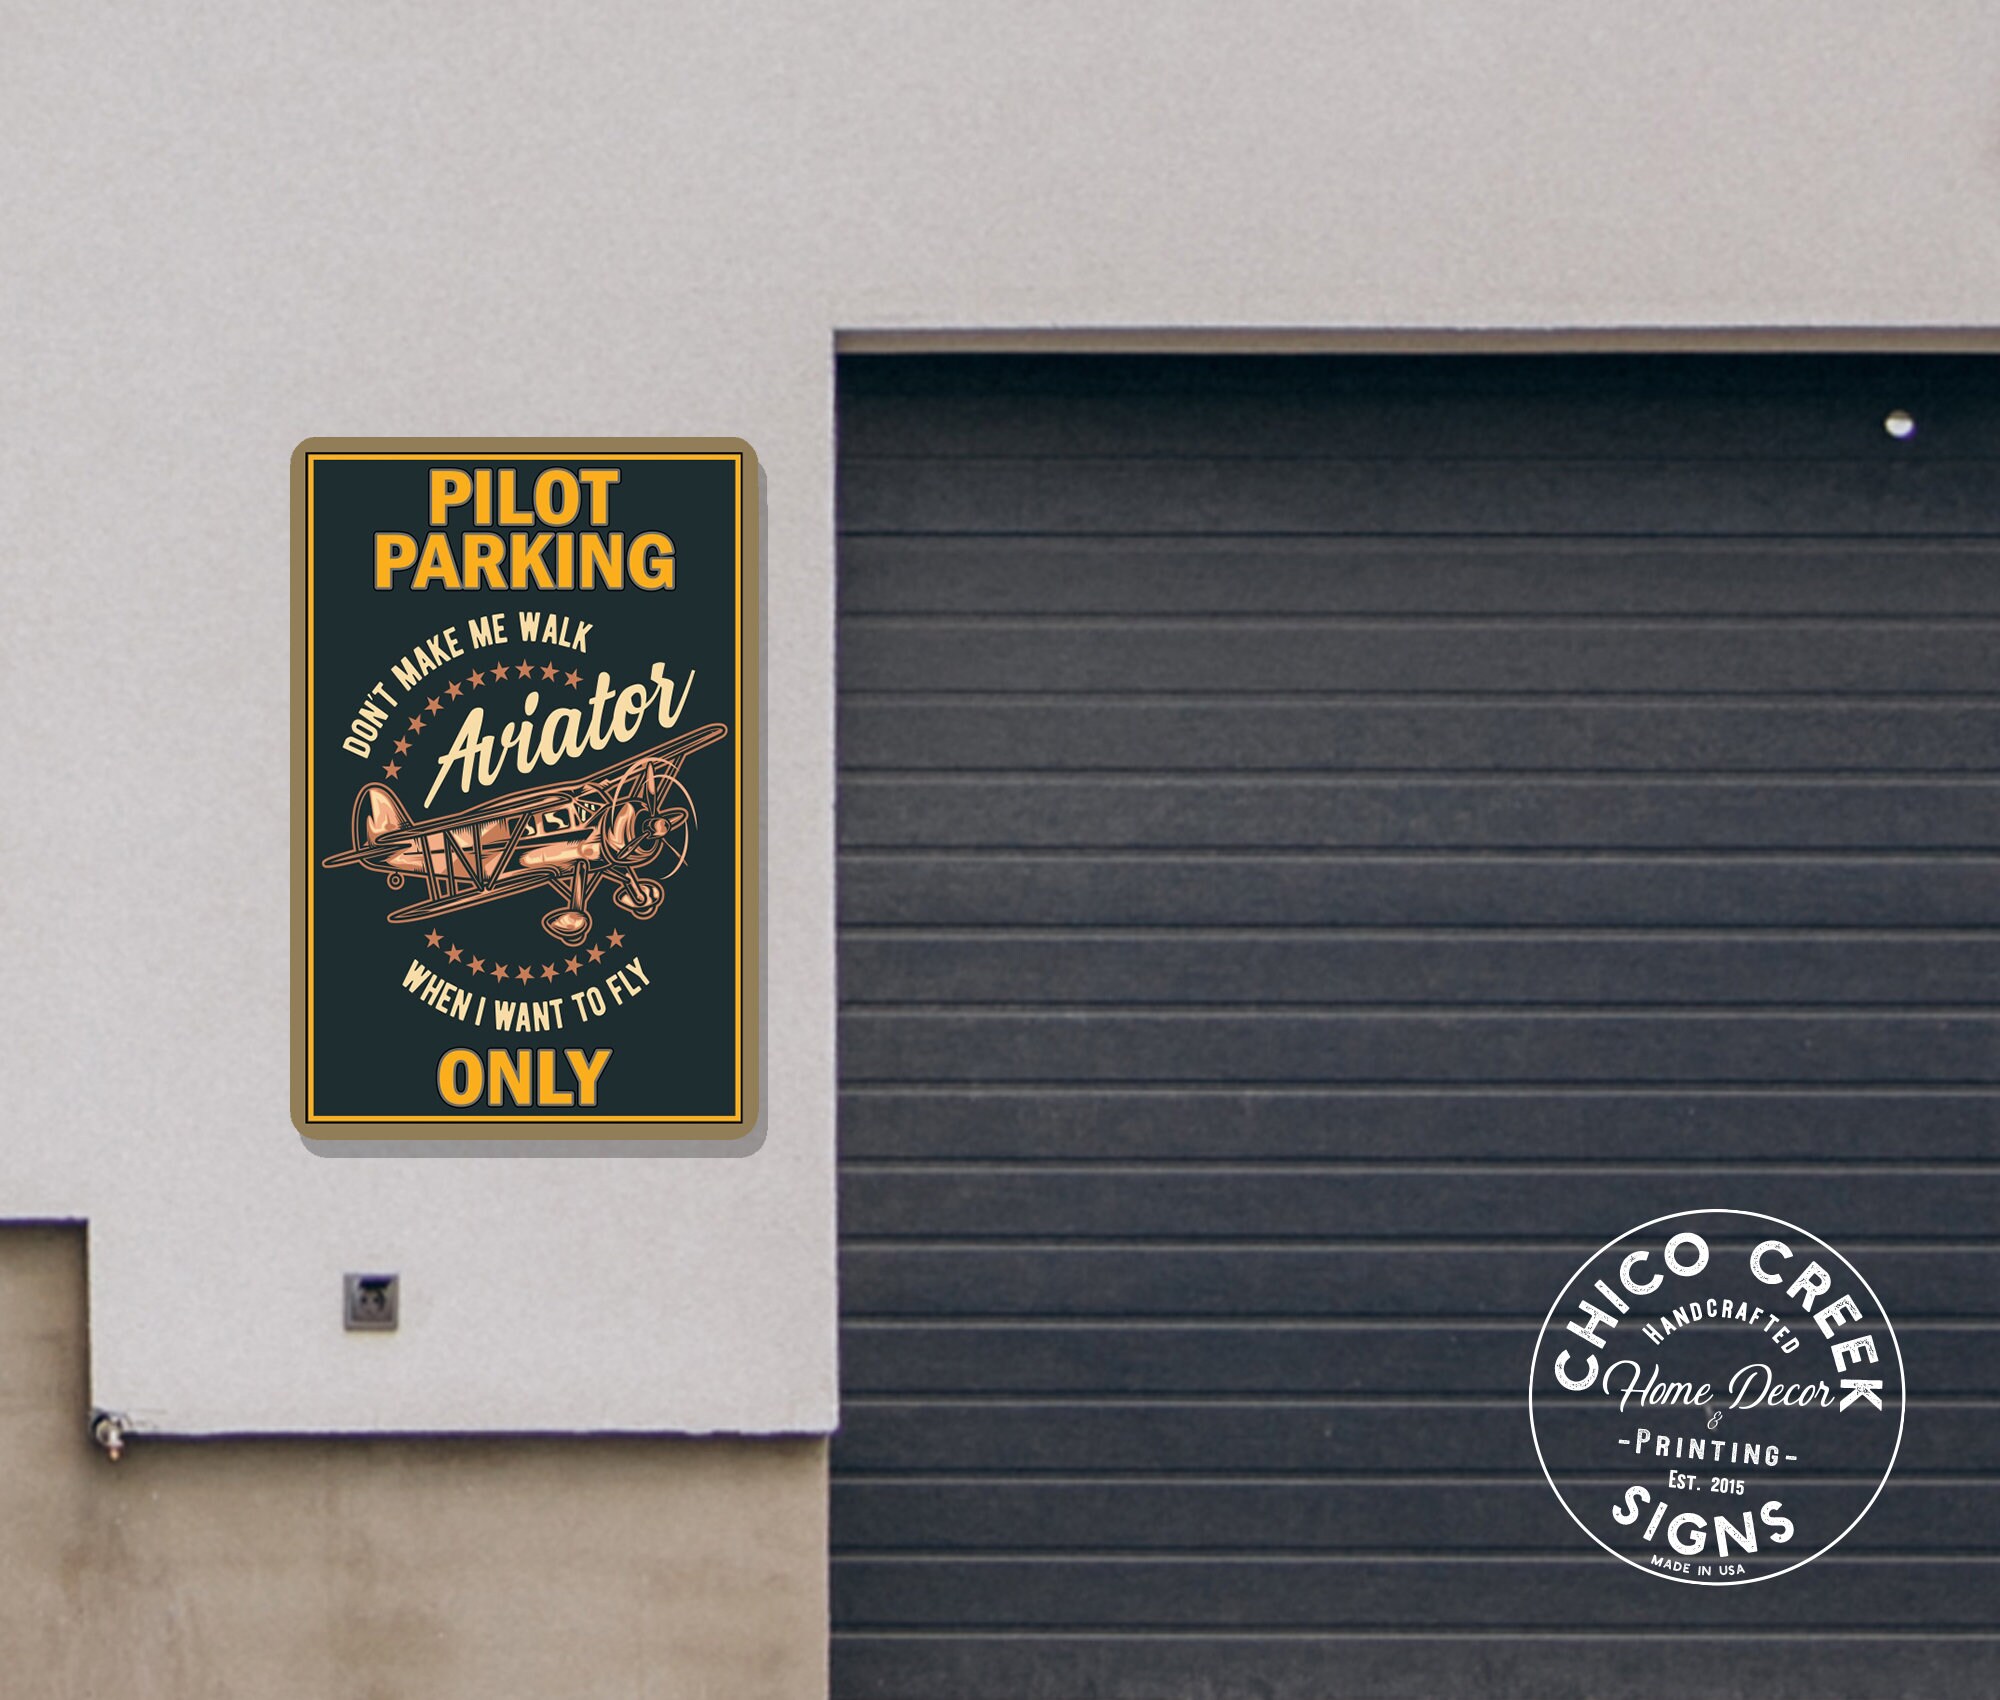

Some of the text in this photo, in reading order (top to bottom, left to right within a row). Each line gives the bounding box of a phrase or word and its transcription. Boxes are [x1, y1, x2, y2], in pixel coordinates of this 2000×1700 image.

[428, 467, 621, 527] PILOT
[374, 531, 677, 591] PARKING
[342, 611, 594, 759] DON'T MAKE ME WALK
[424, 662, 696, 808] Aviator
[402, 956, 650, 1032] WHEN I WANT TO FLY
[436, 1048, 614, 1108] ONLY
